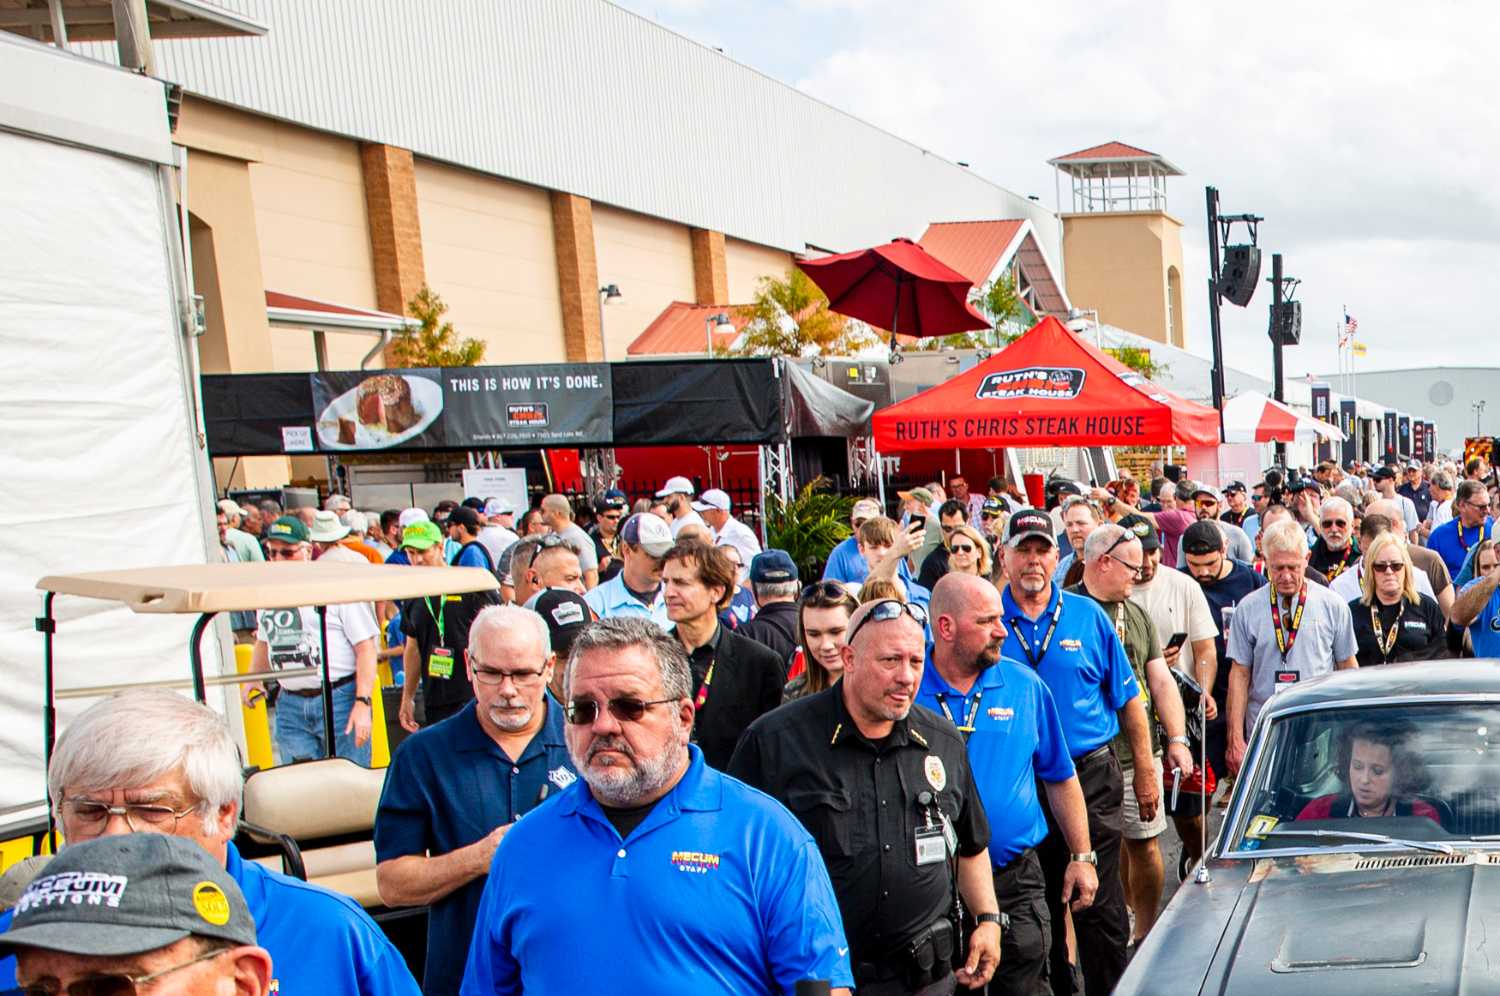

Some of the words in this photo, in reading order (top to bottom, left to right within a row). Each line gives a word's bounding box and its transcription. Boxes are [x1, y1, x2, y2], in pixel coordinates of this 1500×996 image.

[450, 378, 481, 392] THIS
[485, 378, 497, 391] IS
[502, 376, 531, 390] HOW
[536, 376, 561, 389] IT'S
[566, 375, 604, 388] DONE.
[991, 371, 1048, 385] RUTH'S
[982, 388, 1025, 397] STEAK
[1029, 388, 1074, 397] HOUSE
[895, 418, 957, 441] RUTH'S
[964, 417, 1018, 438] CHRIS
[1026, 416, 1078, 436] STEAK
[1085, 416, 1146, 436] HOUSE
[672, 851, 720, 865] MECUM
